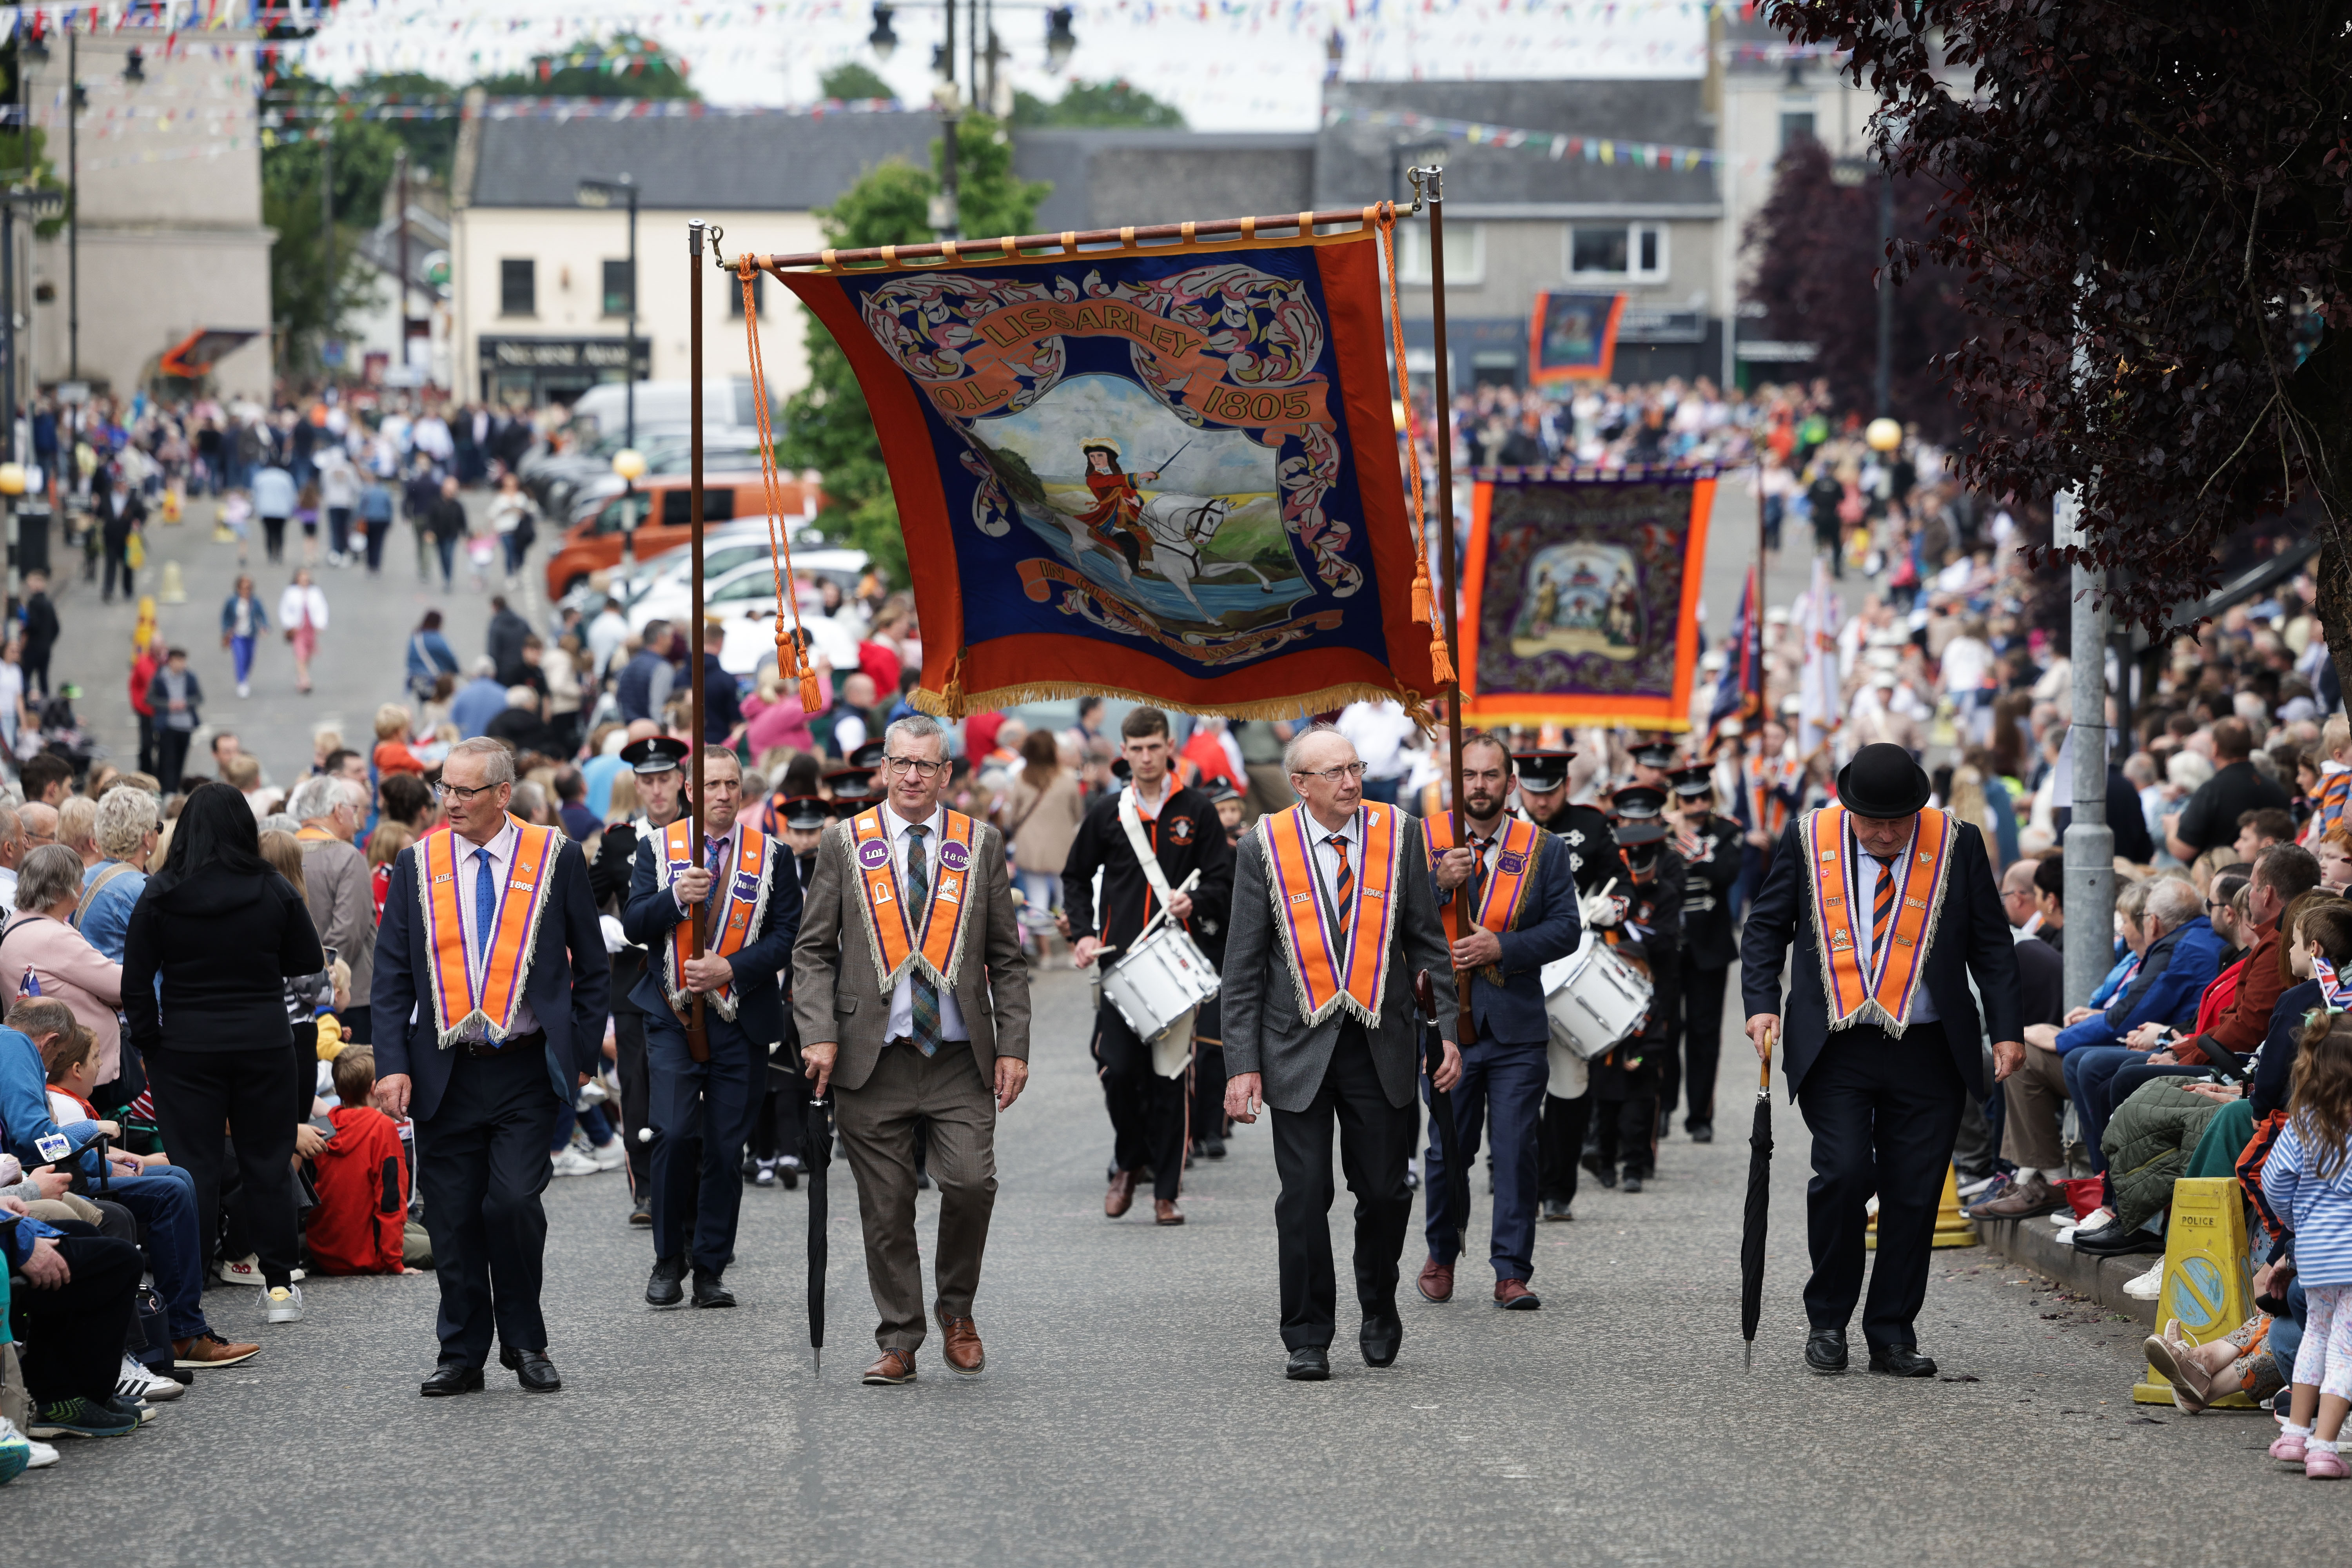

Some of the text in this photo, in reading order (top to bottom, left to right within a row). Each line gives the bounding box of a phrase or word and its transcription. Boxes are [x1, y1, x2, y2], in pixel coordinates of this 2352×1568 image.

[983, 305, 1203, 358] LISSARLEY
[1203, 386, 1310, 421] 1805
[1039, 561, 1065, 580] IN
[865, 848, 886, 860] LOL
[944, 851, 970, 865] 1805
[435, 872, 452, 884] LOL
[509, 880, 534, 892] 1805
[737, 880, 757, 893] 1805
[1290, 892, 1310, 904] LOL
[1363, 887, 1383, 899] 1805
[1824, 897, 1842, 907] LOL
[1905, 896, 1926, 910] 1805
[2182, 1216, 2214, 1225] POLICE
